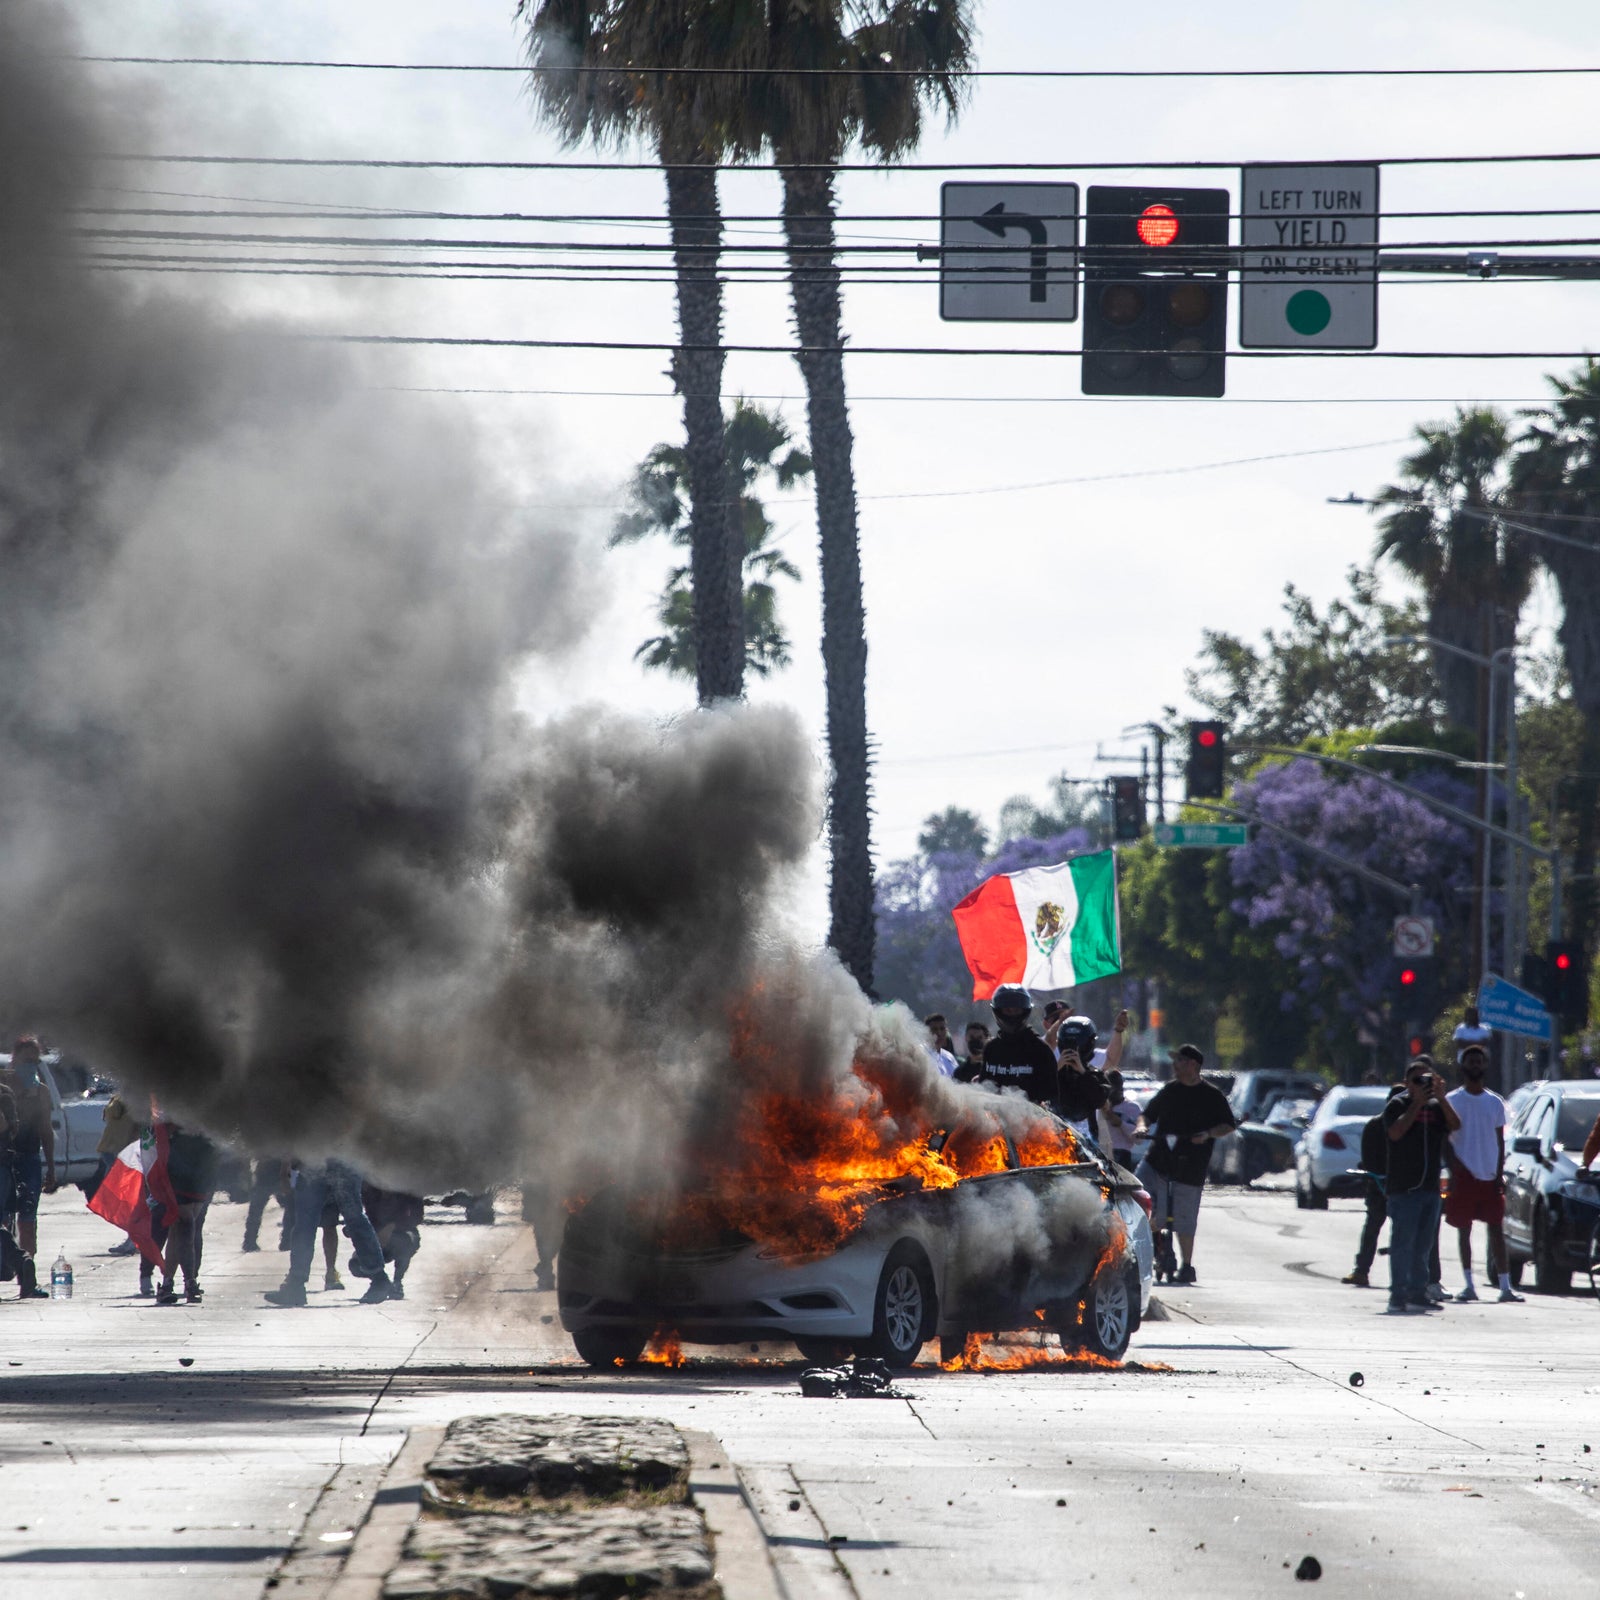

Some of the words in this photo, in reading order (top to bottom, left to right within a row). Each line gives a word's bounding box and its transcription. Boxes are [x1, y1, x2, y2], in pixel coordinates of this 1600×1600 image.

[1259, 191, 1303, 210] LEFT
[1312, 190, 1362, 210] TURN
[1274, 220, 1347, 245] YIELD
[1261, 256, 1287, 275] ON
[1296, 256, 1359, 276] GREEN
